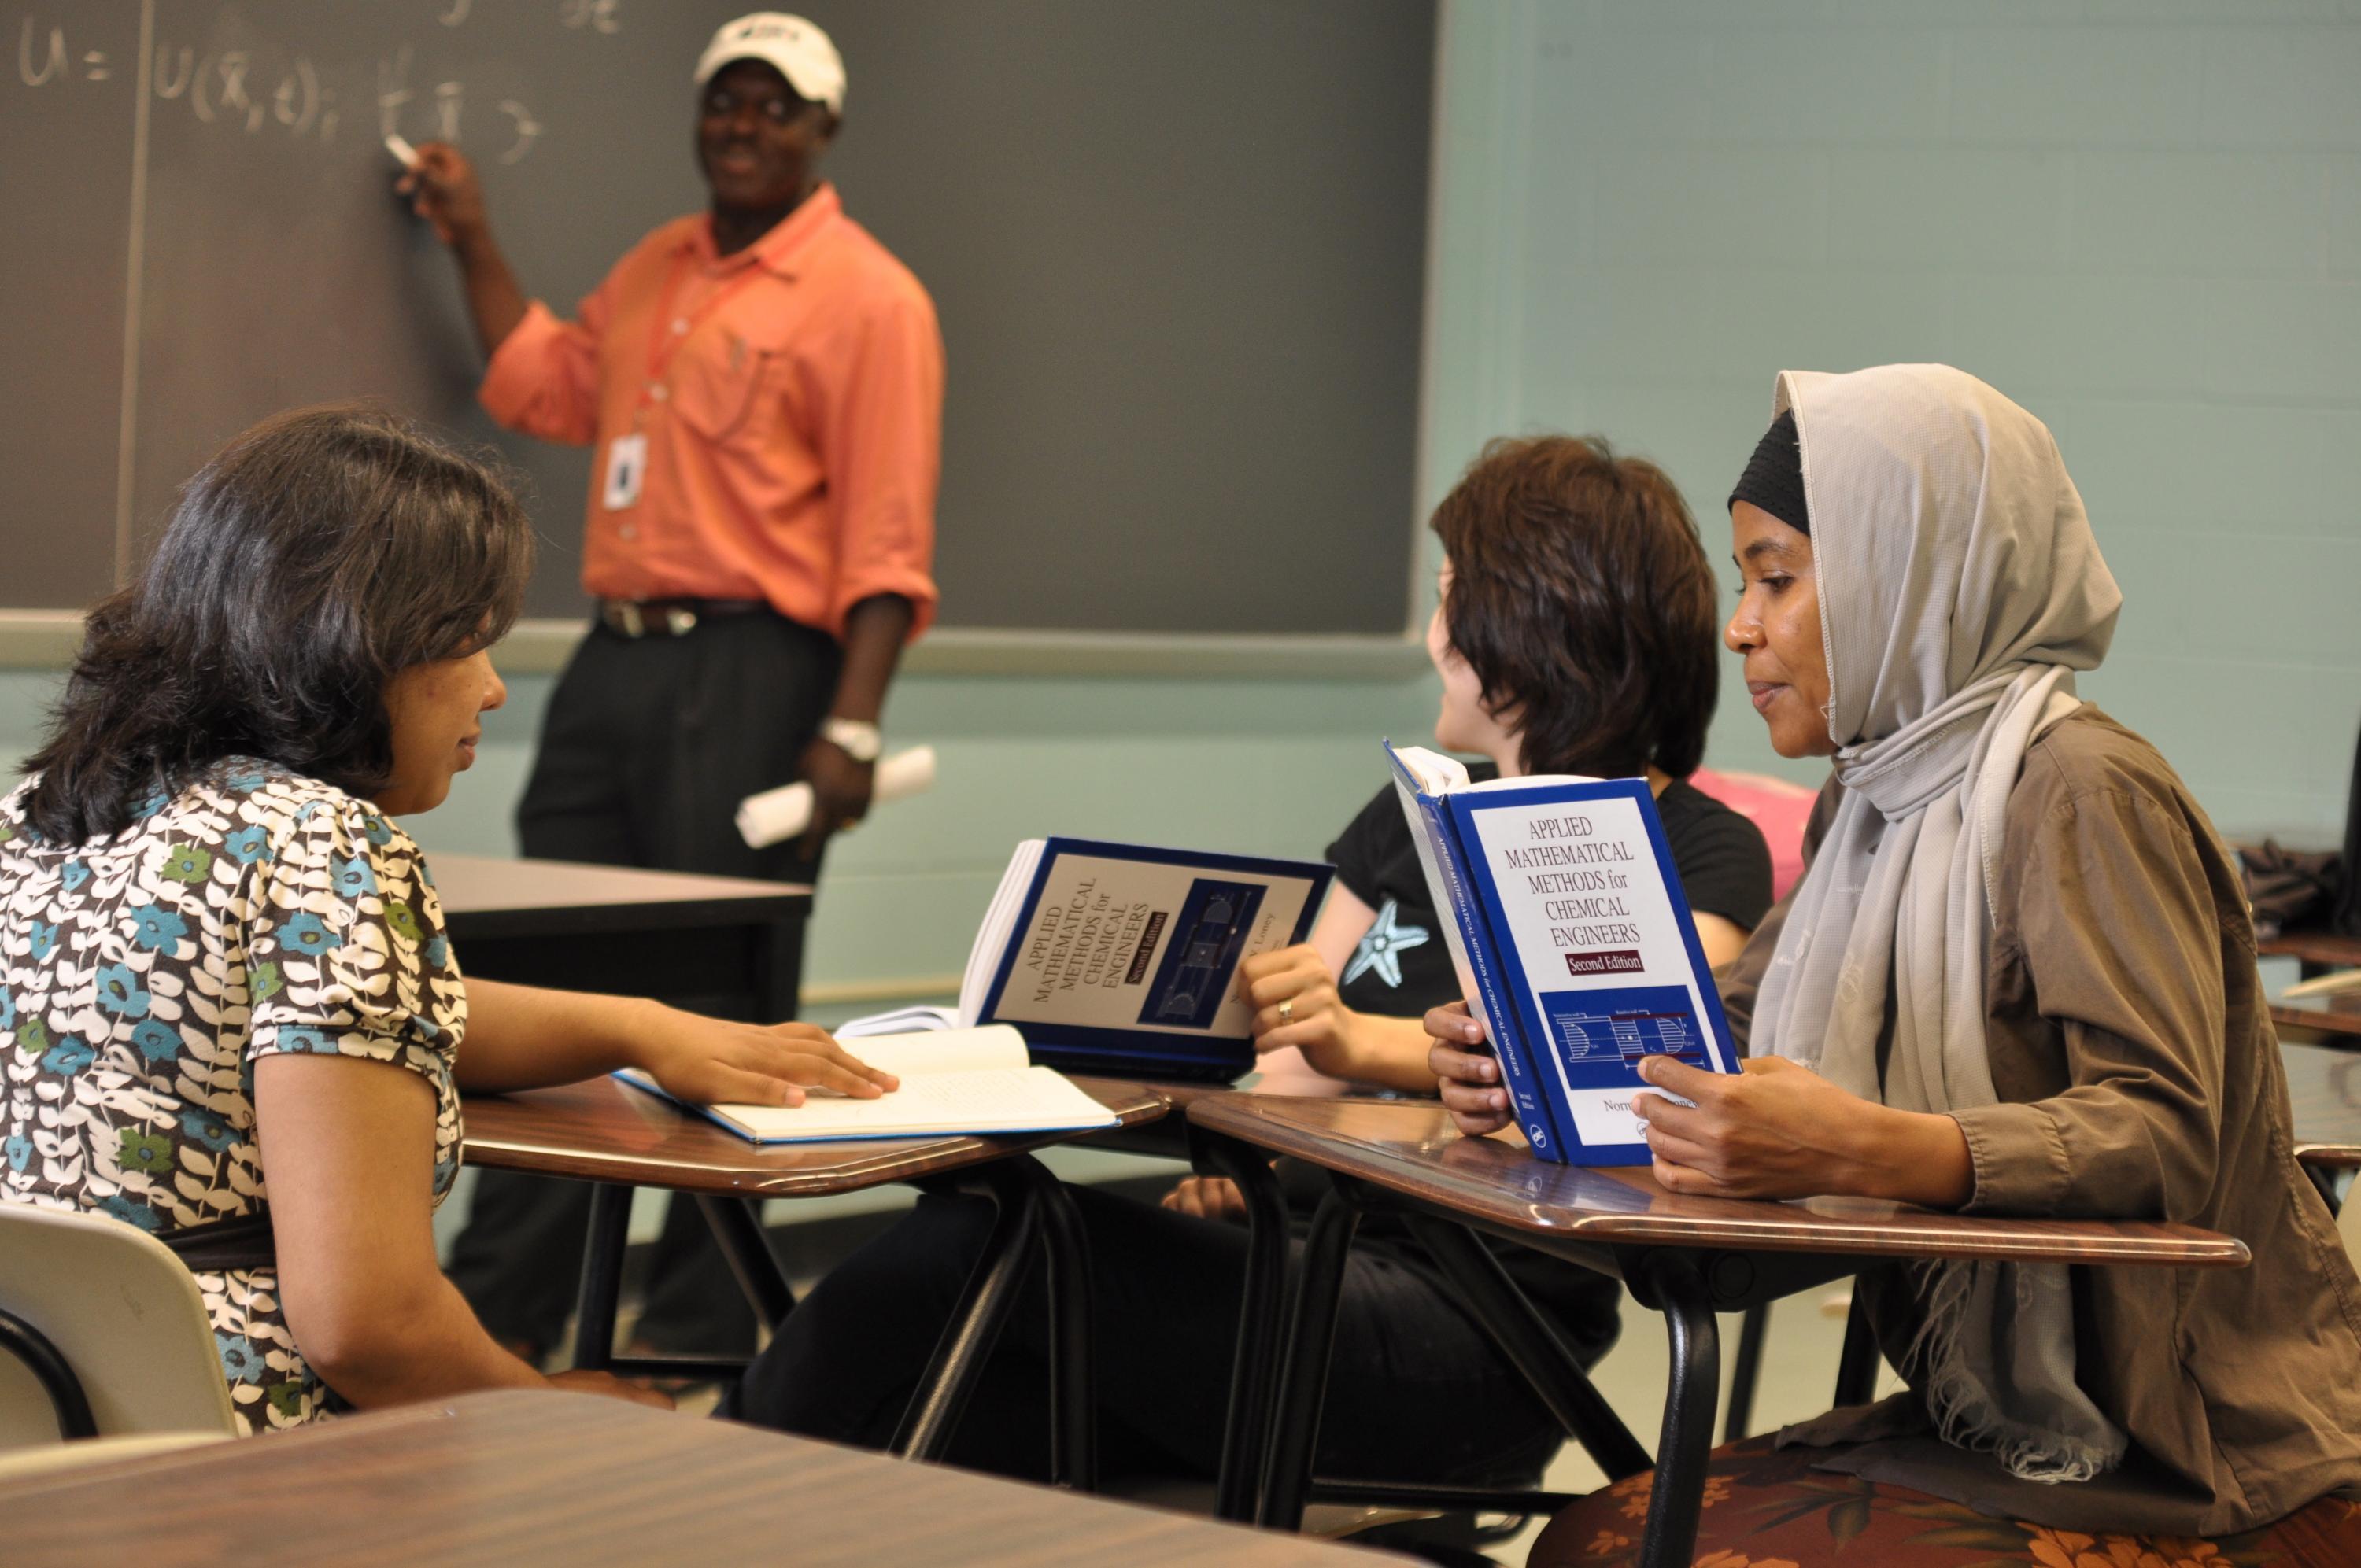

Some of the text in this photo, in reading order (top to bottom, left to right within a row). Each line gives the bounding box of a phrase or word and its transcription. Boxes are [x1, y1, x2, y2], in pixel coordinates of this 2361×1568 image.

[1504, 841, 1635, 869] MATHEMATICAL
[1529, 816, 1593, 840] APPLIED
[1527, 869, 1628, 895] METHODS for
[1545, 896, 1631, 921] CHEMICAL
[1026, 906, 1062, 971] APPLIED
[1033, 877, 1096, 1003] MATHEMATICAL
[1059, 893, 1111, 991] METHODS for
[1082, 903, 1129, 985] CHEMICAL
[1102, 902, 1149, 989] ENGINEERS
[1129, 913, 1166, 983] Second Edition
[1438, 836, 1454, 871] APPLIED
[1450, 871, 1474, 939] MATHEMATICAL
[1470, 937, 1488, 977] METHODS
[1487, 987, 1505, 1031] CHEMICAL
[1502, 1031, 1521, 1078] ENGINEERS
[1550, 923, 1641, 947] ENGINEERS
[1568, 954, 1642, 972] Second Edition
